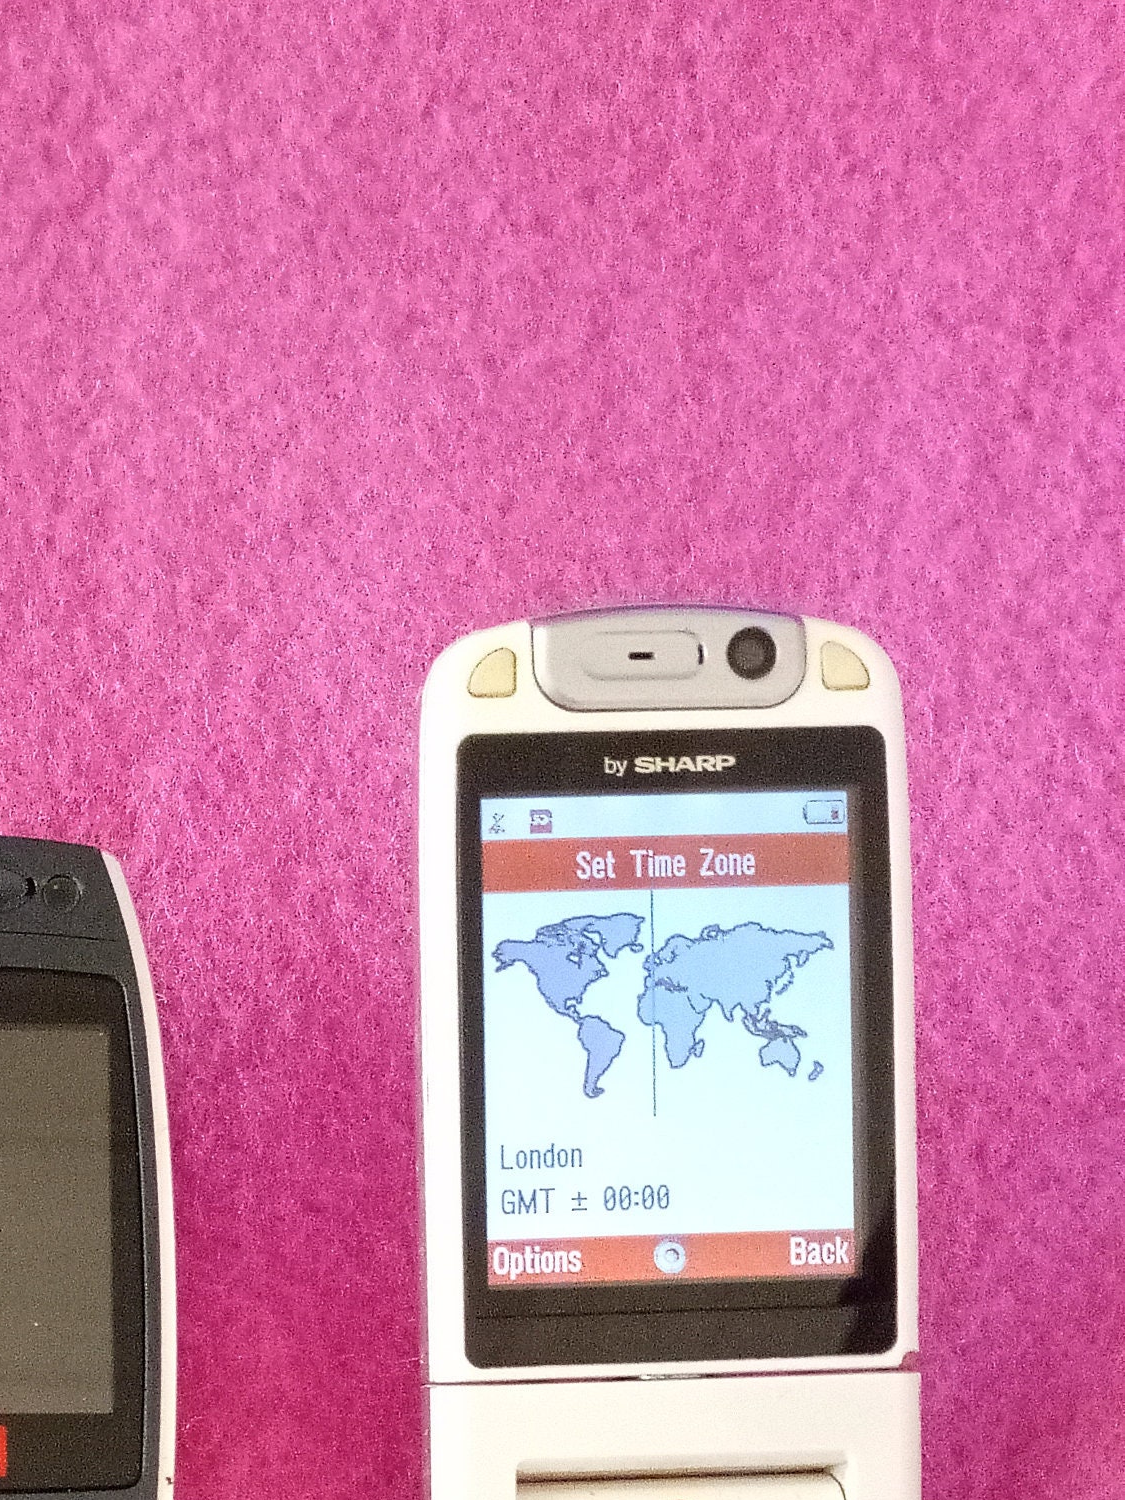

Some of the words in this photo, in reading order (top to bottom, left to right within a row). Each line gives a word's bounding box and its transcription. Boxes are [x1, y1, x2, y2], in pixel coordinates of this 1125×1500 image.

[604, 756, 628, 776] by
[633, 755, 736, 774] SHARP
[575, 851, 616, 880] Set
[631, 850, 686, 878] Time
[699, 848, 756, 877] Zone
[500, 1144, 584, 1170] London
[500, 1188, 556, 1216] GMT
[603, 1184, 670, 1212] 00:00
[492, 1247, 582, 1276] Options
[789, 1236, 849, 1266] Back
